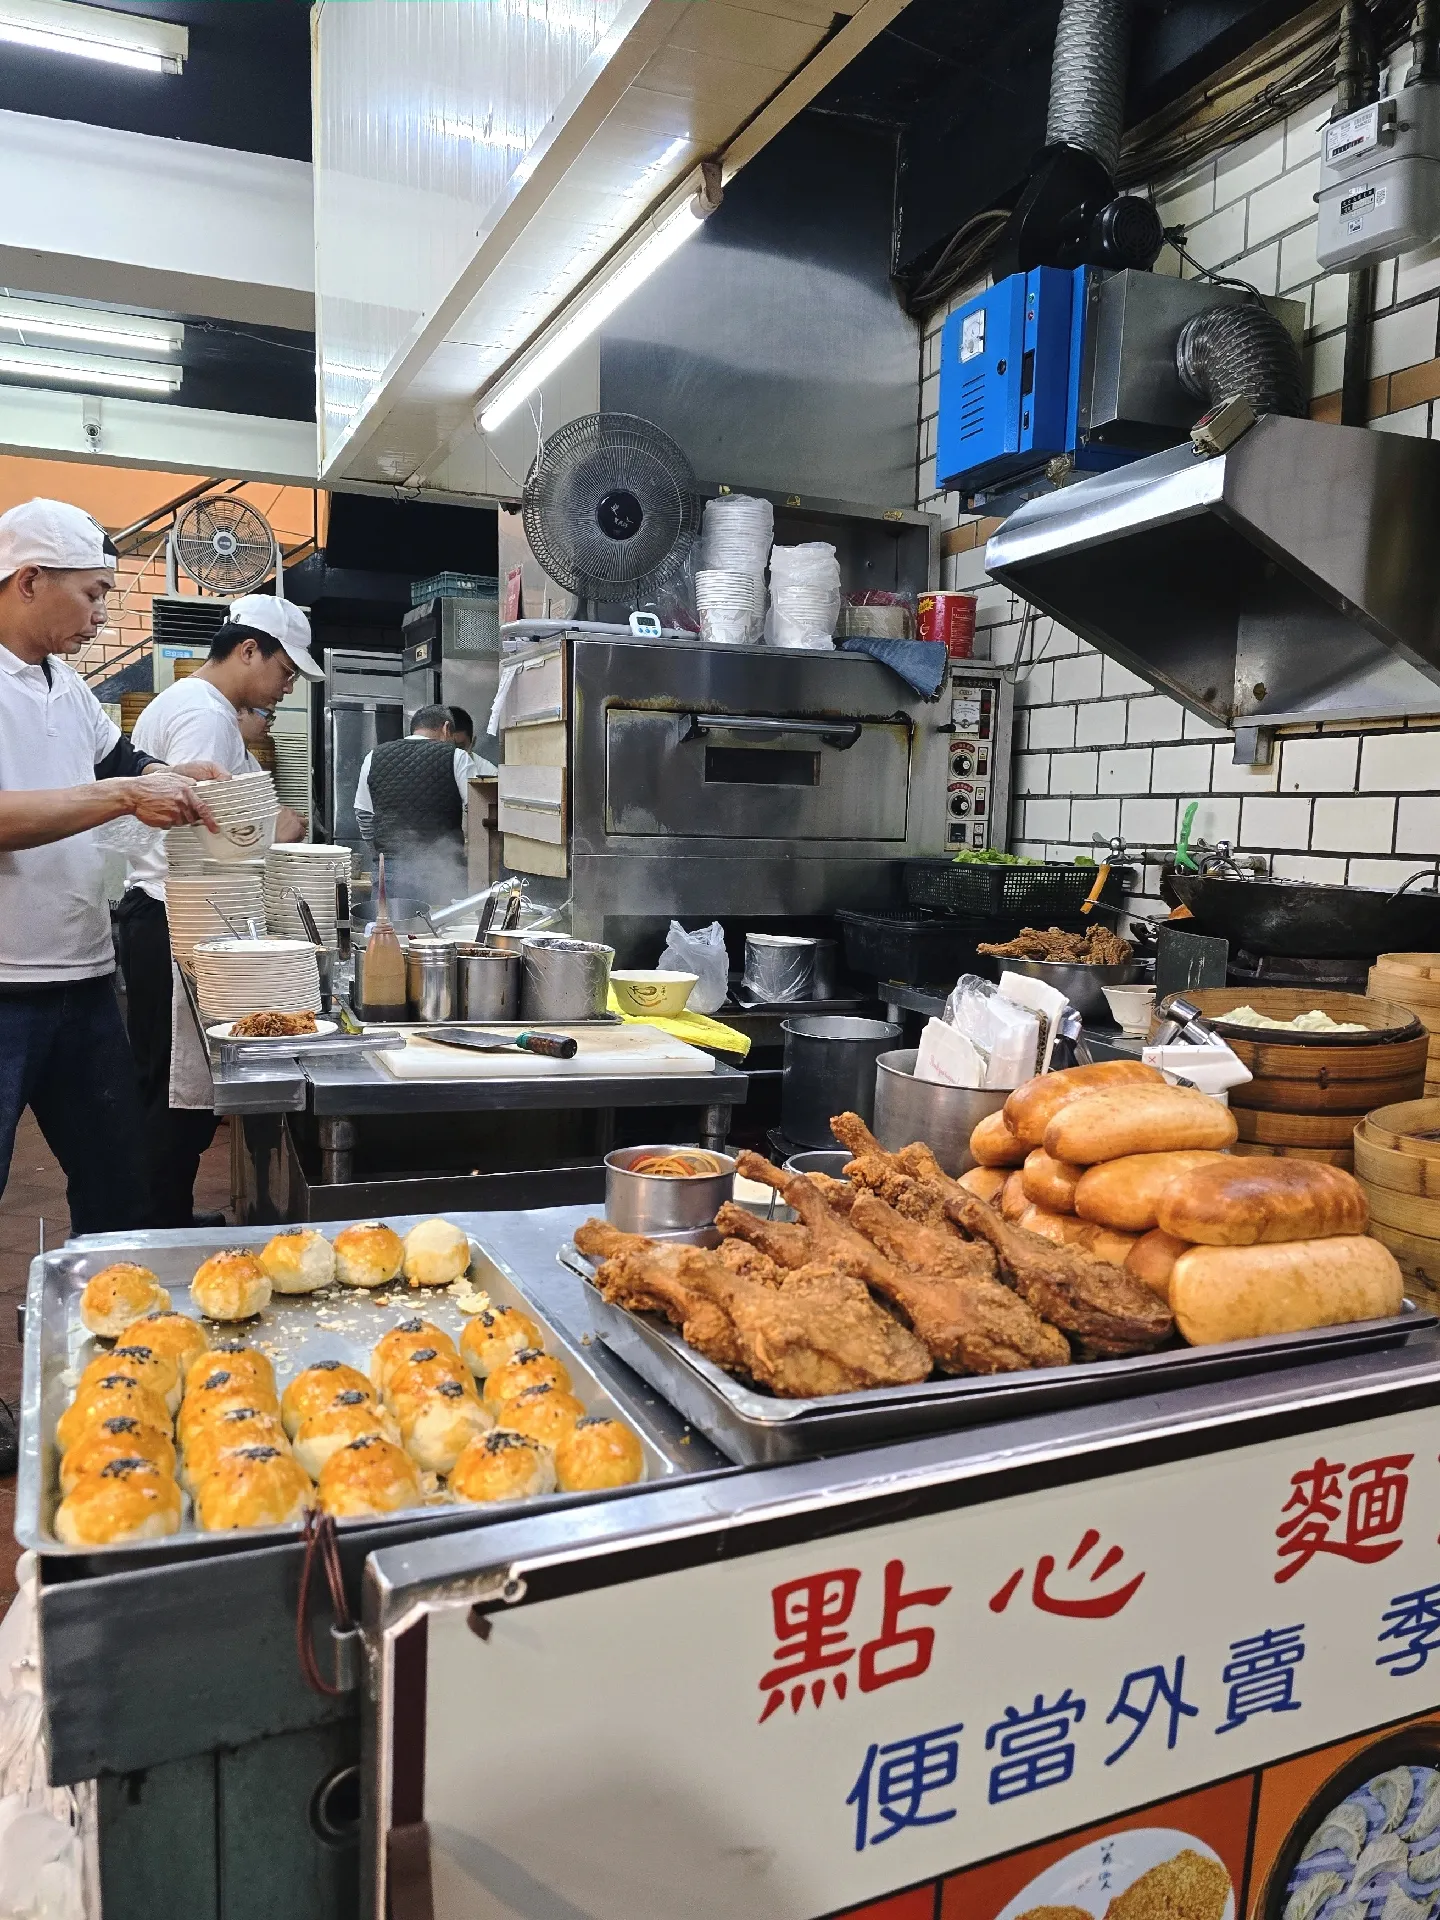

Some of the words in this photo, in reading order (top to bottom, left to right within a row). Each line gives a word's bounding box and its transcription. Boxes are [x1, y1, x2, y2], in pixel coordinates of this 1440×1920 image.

[758, 1528, 1146, 1723] 點心
[1274, 1453, 1440, 1583] 麵
[846, 1624, 1307, 1852] 便當外賣
